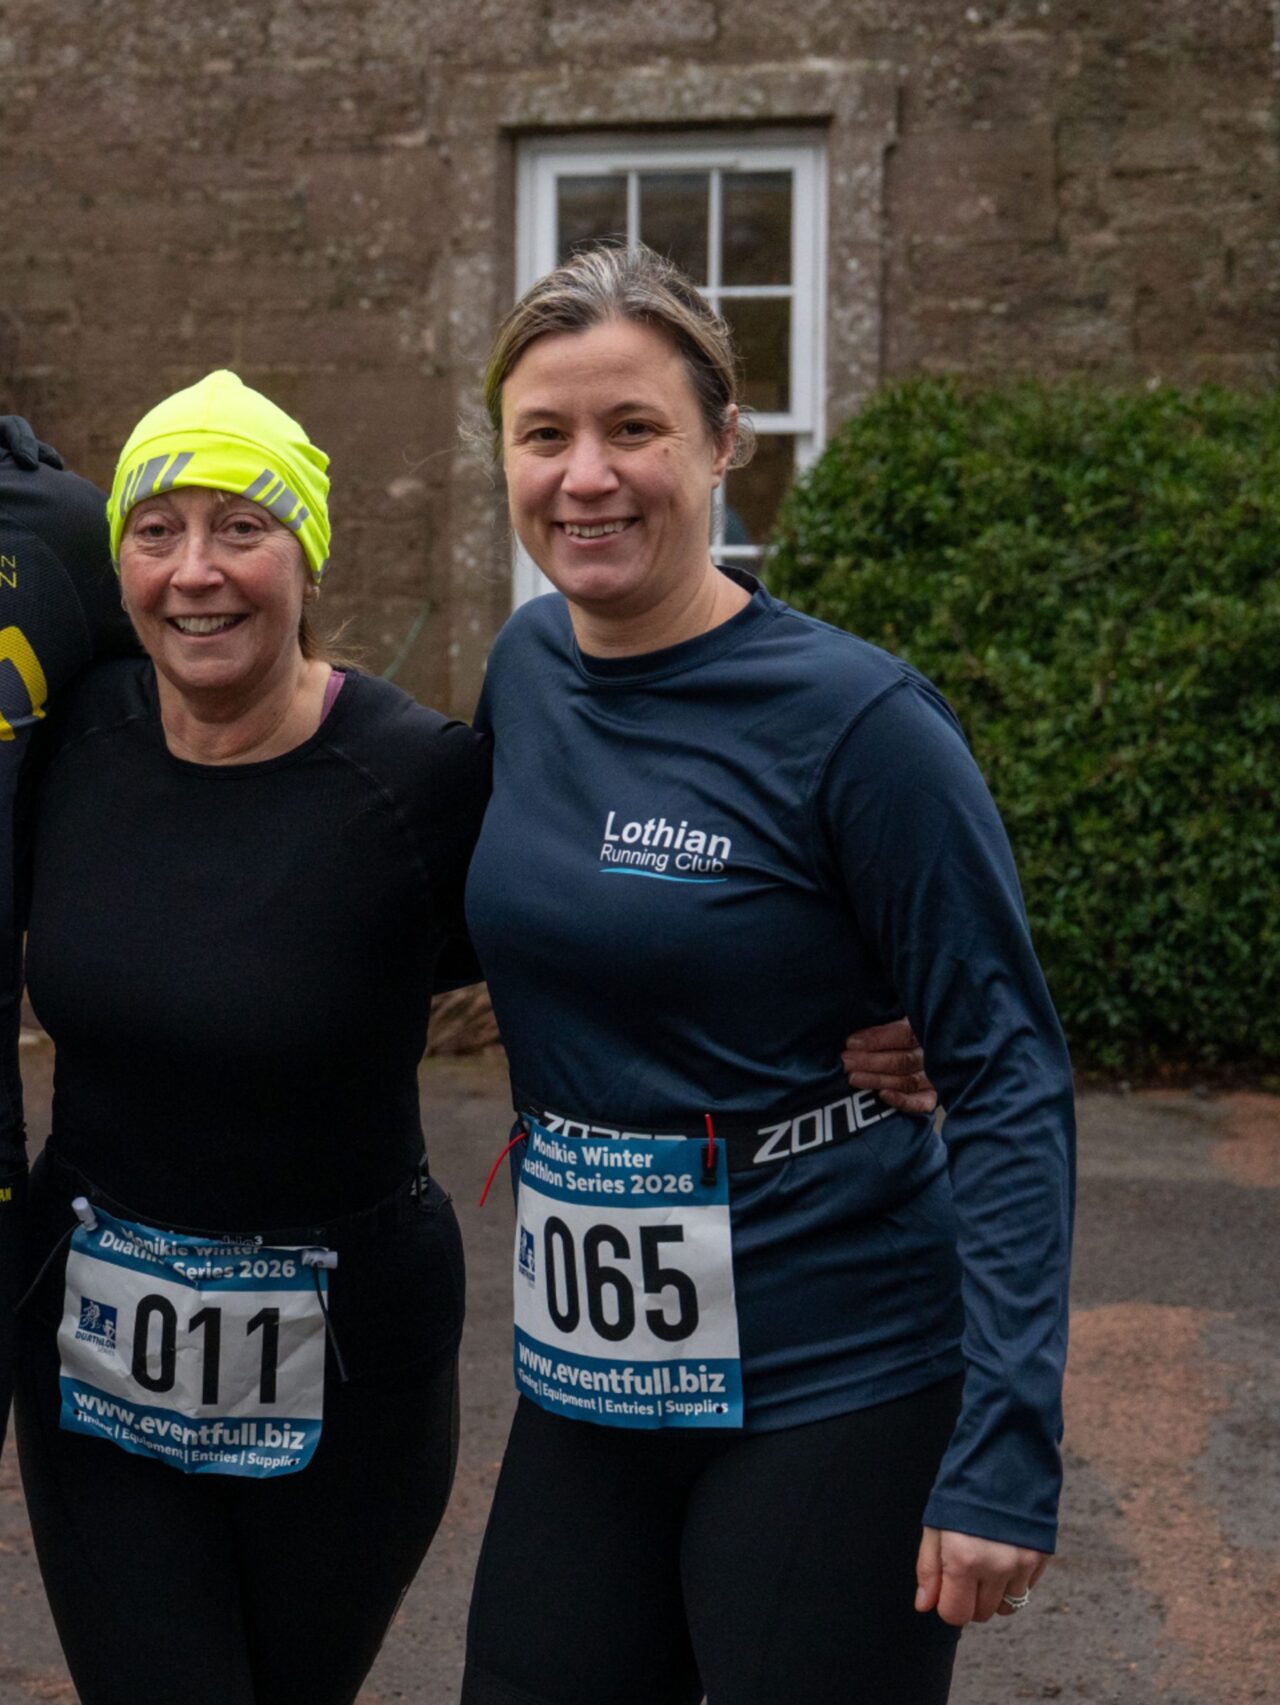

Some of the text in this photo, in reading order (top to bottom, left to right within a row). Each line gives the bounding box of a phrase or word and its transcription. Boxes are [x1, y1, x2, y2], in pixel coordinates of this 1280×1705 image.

[604, 811, 732, 860] Lothian
[600, 843, 725, 873] Running Club
[533, 1132, 654, 1169] Monikie Winter
[522, 1157, 694, 1195] uathlon Series 2026
[173, 1261, 233, 1281] Series
[239, 1260, 296, 1278] 2026
[543, 1215, 699, 1342] 065
[131, 1294, 280, 1405] 011
[519, 1342, 726, 1395] www.eventfull.biz
[543, 1382, 596, 1410] Equipment
[605, 1399, 654, 1416] Entries
[72, 1391, 306, 1451] www.eventfull.biz
[191, 1450, 238, 1464] Entries
